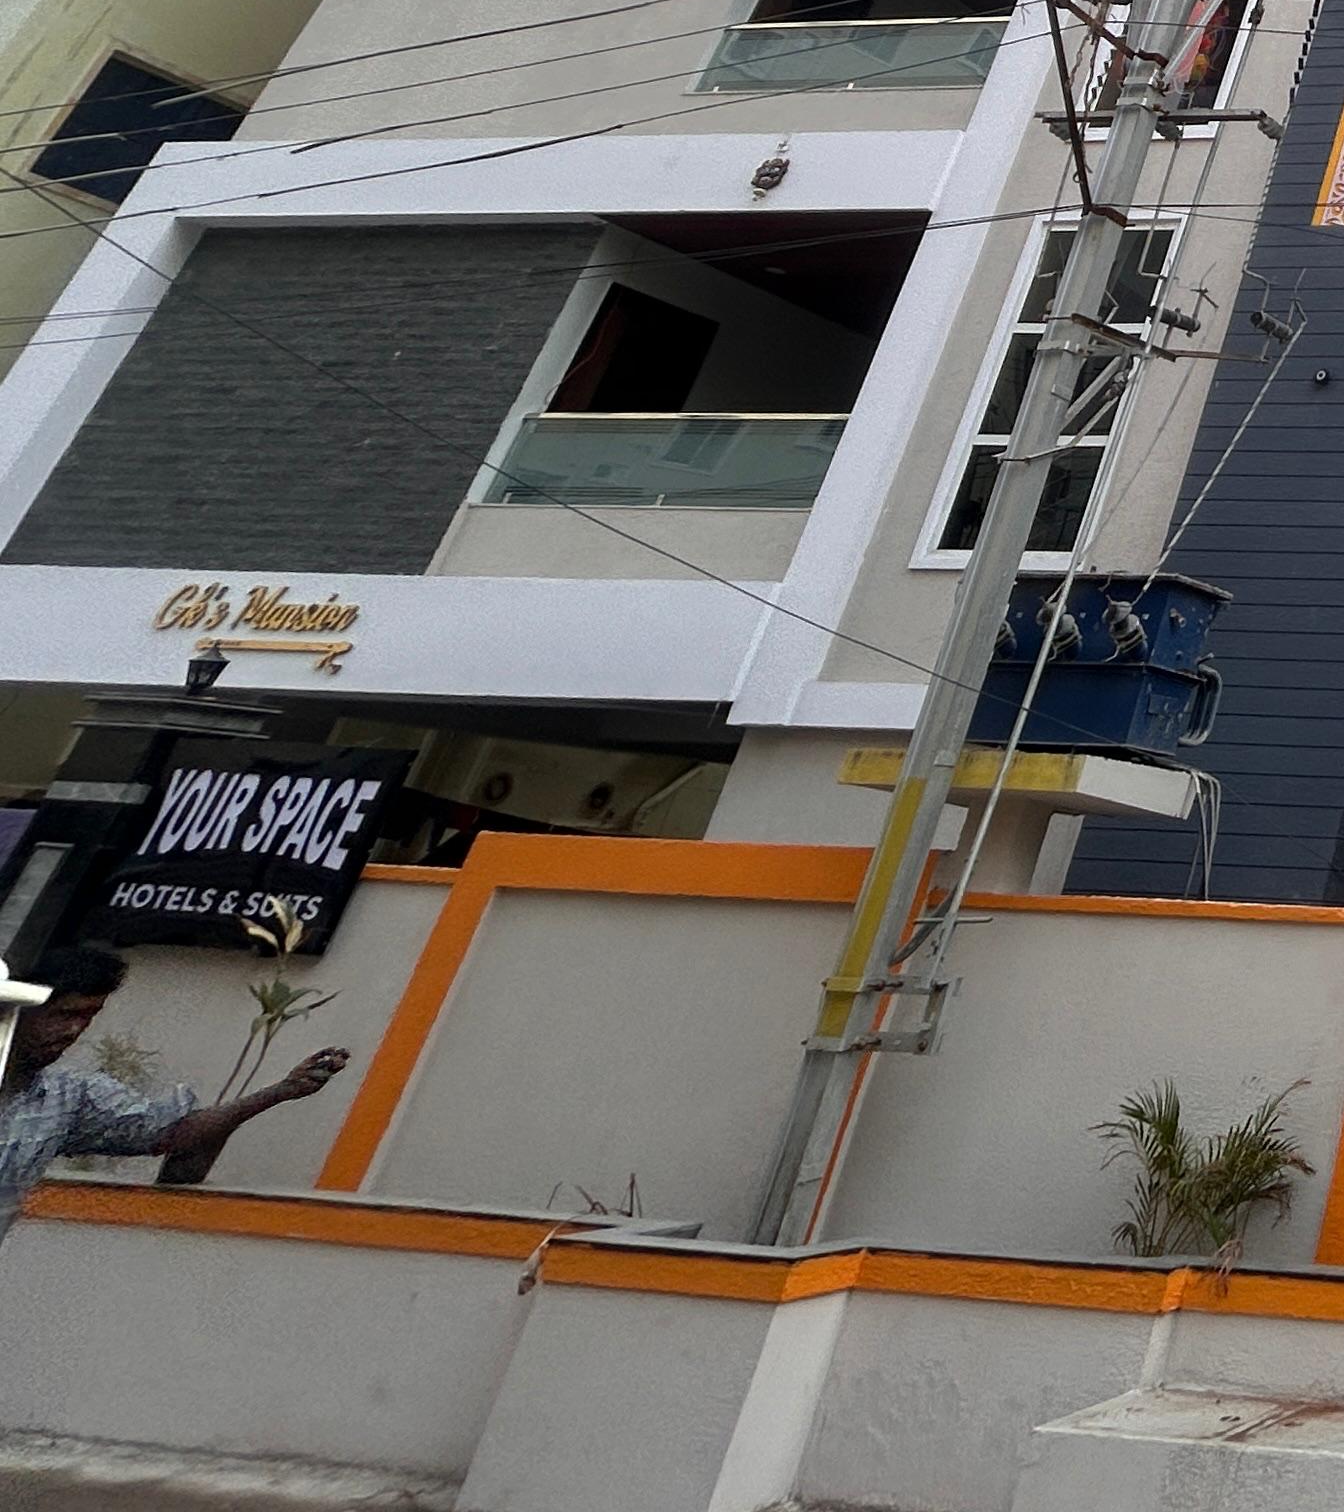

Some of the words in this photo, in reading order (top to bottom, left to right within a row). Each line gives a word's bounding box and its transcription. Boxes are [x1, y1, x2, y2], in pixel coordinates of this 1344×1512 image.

[231, 586, 360, 632] Mansion
[137, 768, 260, 856] YOUR
[241, 775, 382, 870] SPACE
[110, 882, 217, 913] HOTELS
[218, 890, 240, 915] &
